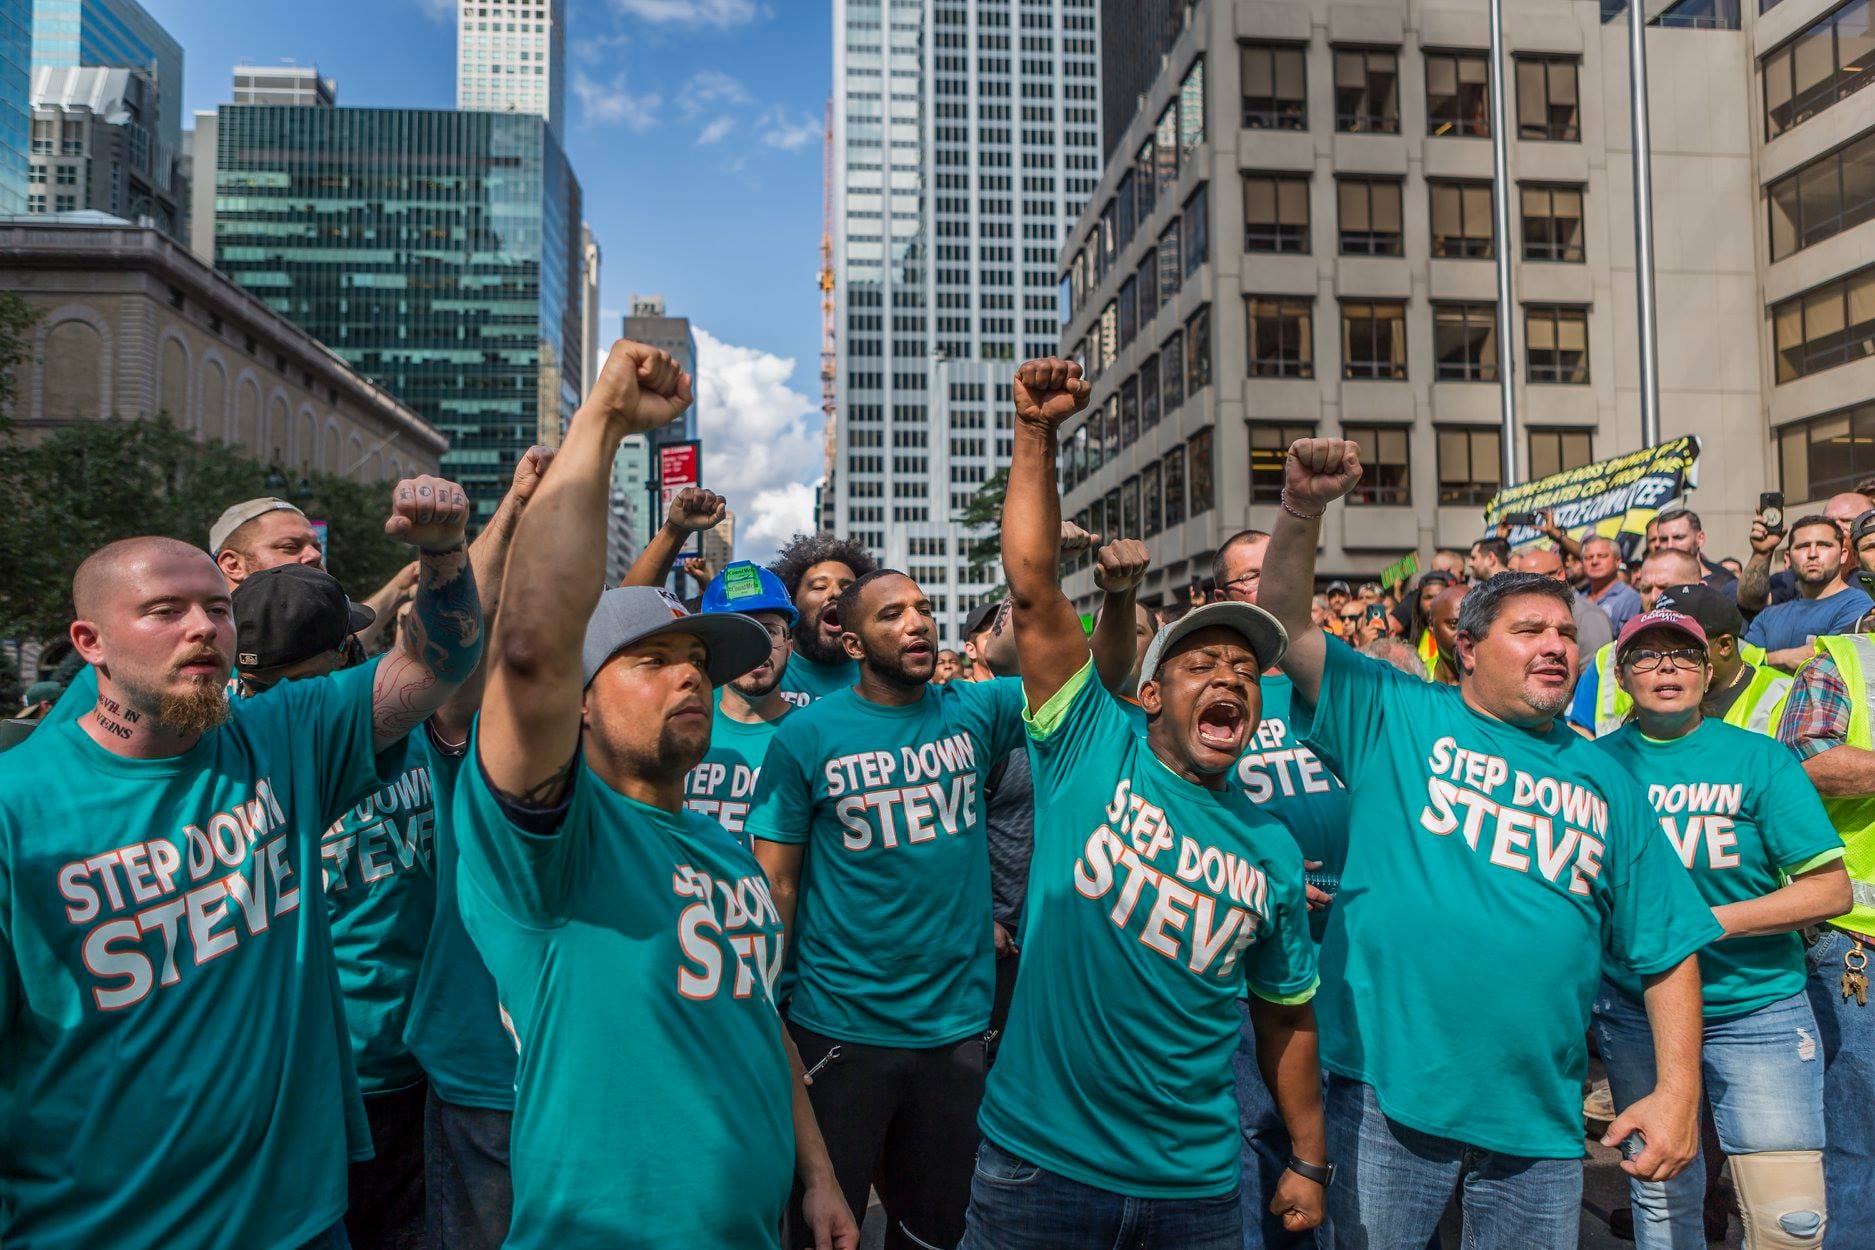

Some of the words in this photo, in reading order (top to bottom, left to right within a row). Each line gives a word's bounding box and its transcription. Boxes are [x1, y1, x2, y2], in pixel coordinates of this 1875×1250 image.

[95, 712, 133, 740] VEINS
[98, 693, 120, 717] EVIL
[123, 708, 141, 724] IN
[684, 763, 727, 796] TEP
[825, 750, 897, 797] STEP
[900, 731, 977, 783] DOWN
[1238, 747, 1346, 805] STE
[1428, 736, 1509, 796] STEP
[1512, 769, 1609, 841] DOWN
[1647, 782, 1743, 816] DOWN
[57, 837, 181, 925] STEP
[182, 776, 288, 881] DOWN
[320, 808, 435, 894] TEVE
[836, 771, 977, 851] STEVE
[1106, 778, 1175, 862] STEP
[1175, 835, 1270, 923] DOWN
[1419, 775, 1606, 897] STEVE
[81, 833, 300, 1012] STEVE
